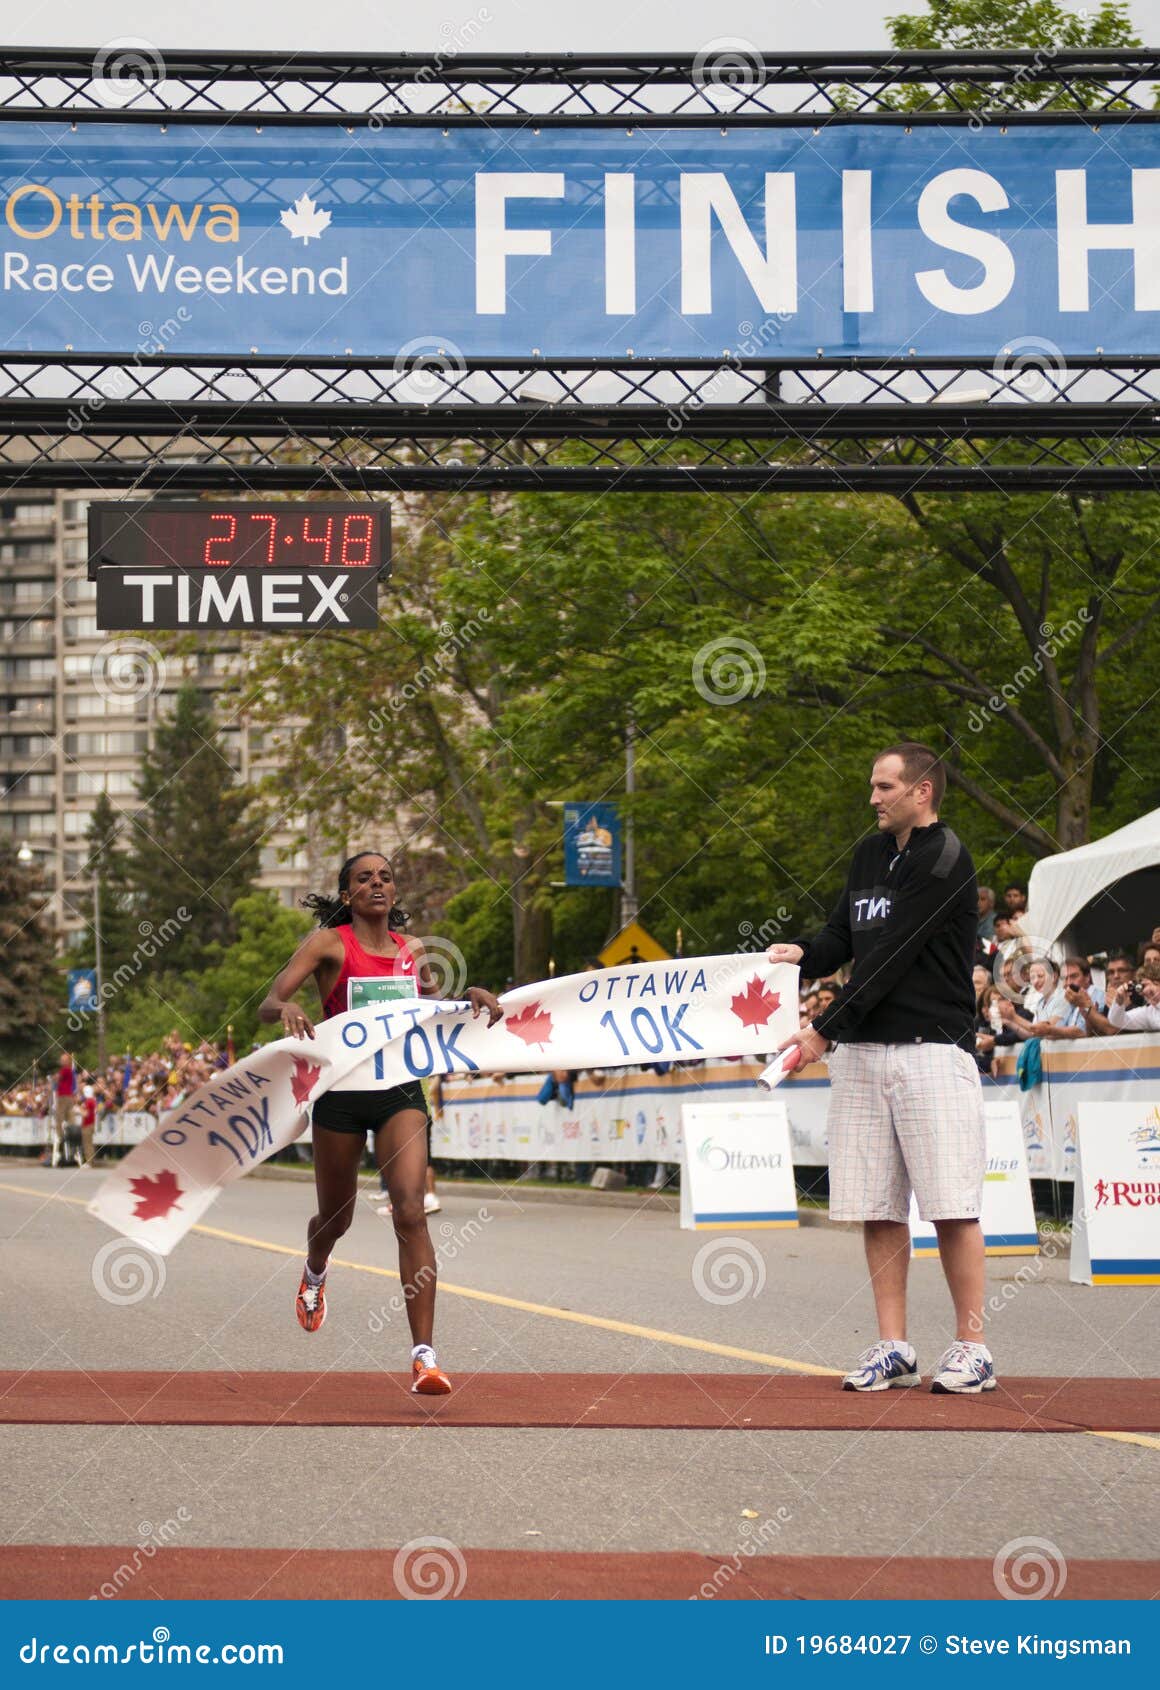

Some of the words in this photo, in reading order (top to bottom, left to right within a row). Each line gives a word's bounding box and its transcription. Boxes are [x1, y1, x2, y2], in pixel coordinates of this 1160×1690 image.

[5, 184, 240, 243] Ottawa
[475, 167, 1160, 314] FINISH
[3, 252, 114, 292] Race
[127, 254, 348, 295] Weekend
[578, 968, 708, 1003] OTTAWA
[600, 1003, 704, 1056] 10K
[161, 1070, 271, 1146] OTTAWA
[208, 1096, 274, 1167] 10K
[706, 1146, 783, 1171] Ottawa
